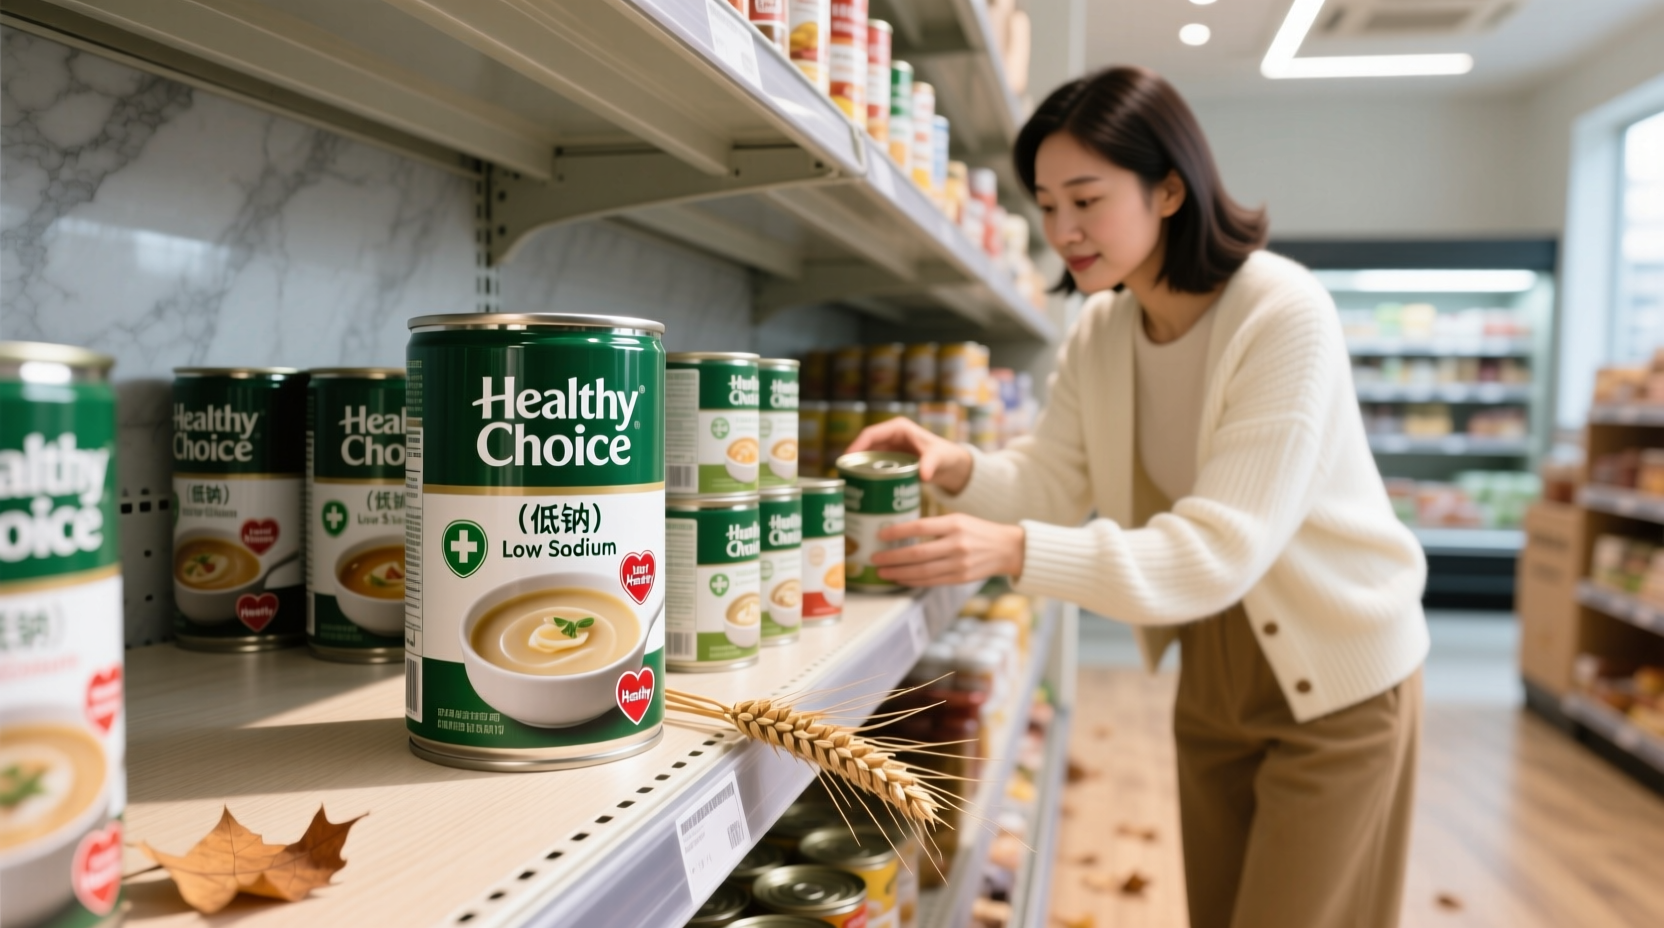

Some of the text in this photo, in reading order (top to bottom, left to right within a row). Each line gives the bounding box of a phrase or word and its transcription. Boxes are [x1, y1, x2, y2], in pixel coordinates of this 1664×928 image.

[172, 403, 259, 439] Healthy
[472, 376, 639, 432] Healthy
[172, 432, 254, 463] Choice
[476, 421, 632, 467] Choice
[518, 502, 602, 534] （低钠）
[502, 538, 617, 558] Low Sodium
